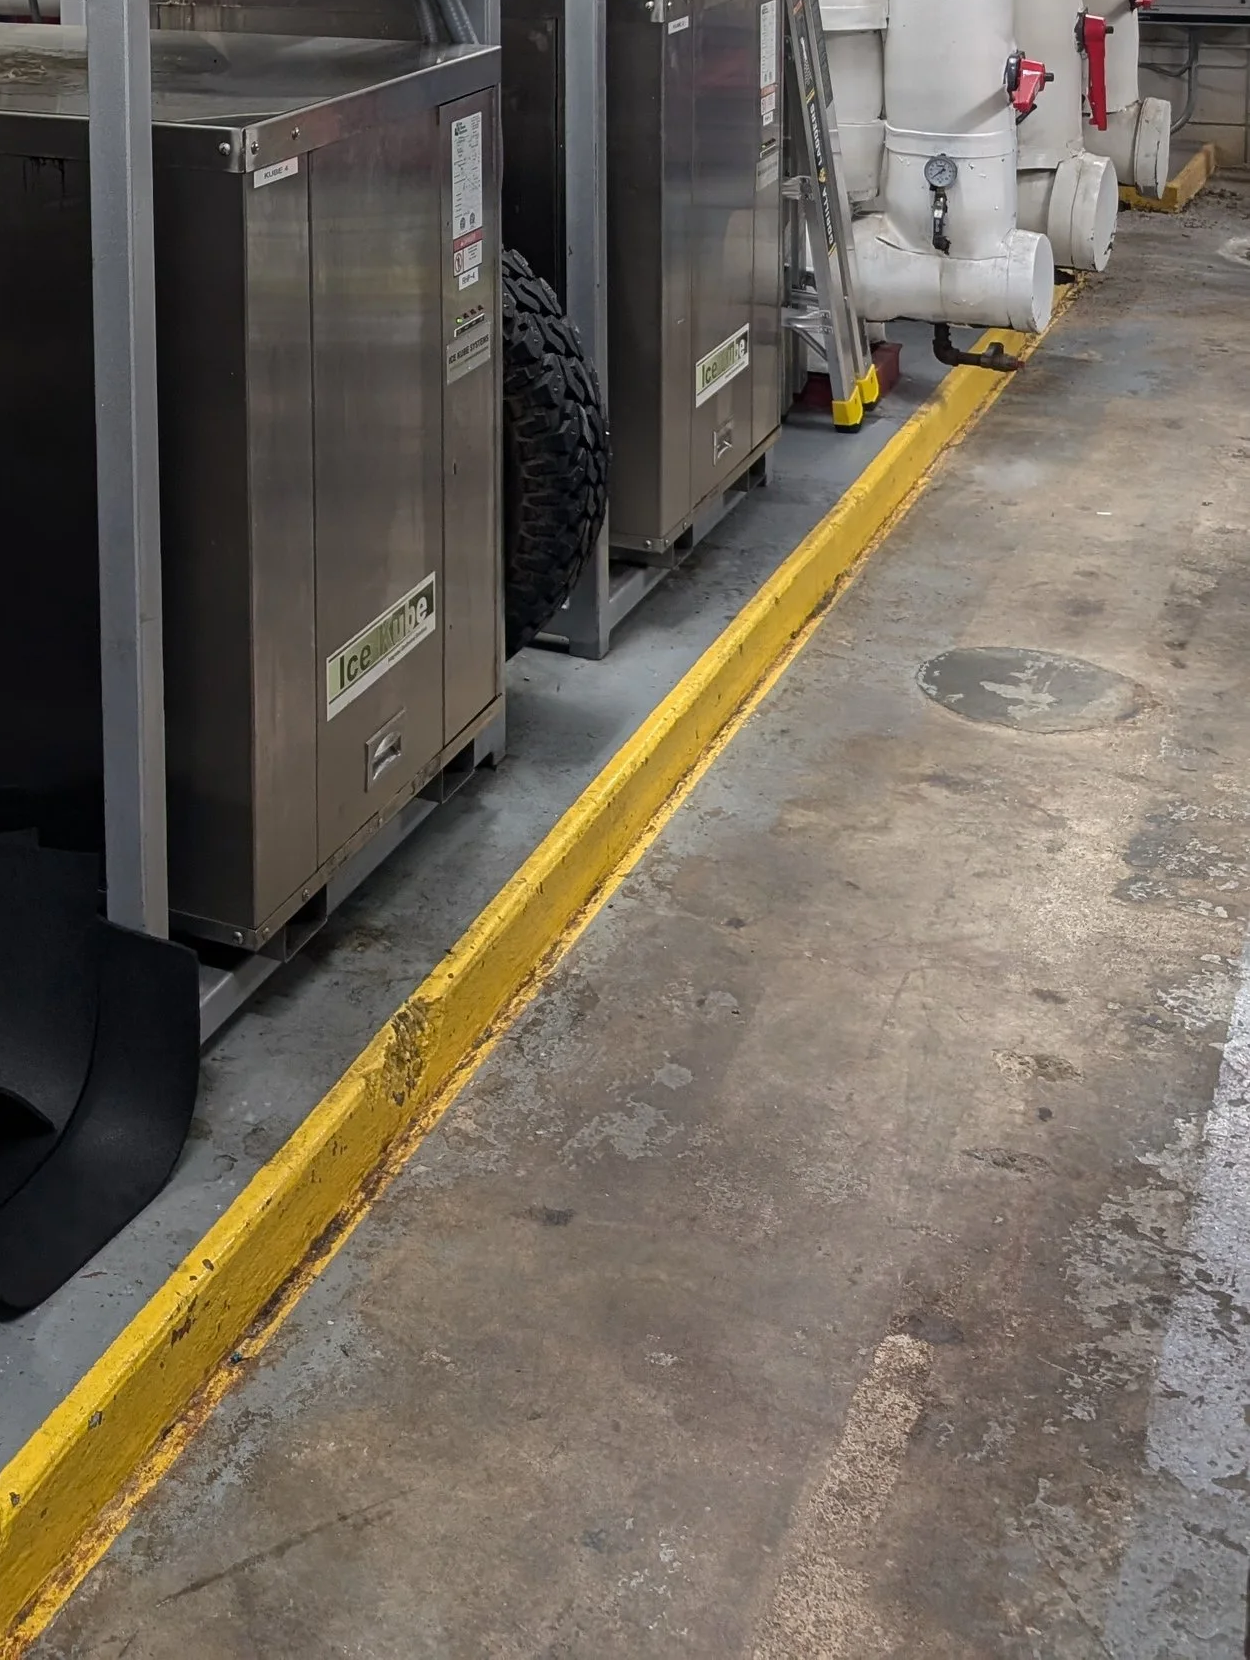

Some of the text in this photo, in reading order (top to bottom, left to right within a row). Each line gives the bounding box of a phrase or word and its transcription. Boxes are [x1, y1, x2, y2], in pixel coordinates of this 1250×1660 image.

[810, 103, 823, 167] LADDERS
[263, 166, 284, 180] KUBE
[822, 186, 834, 245] GORILLA
[448, 334, 490, 365] ICE KUBE SYSTEMS
[702, 362, 718, 388] Ice
[338, 643, 372, 690] Ice
[378, 595, 429, 658] Kube
